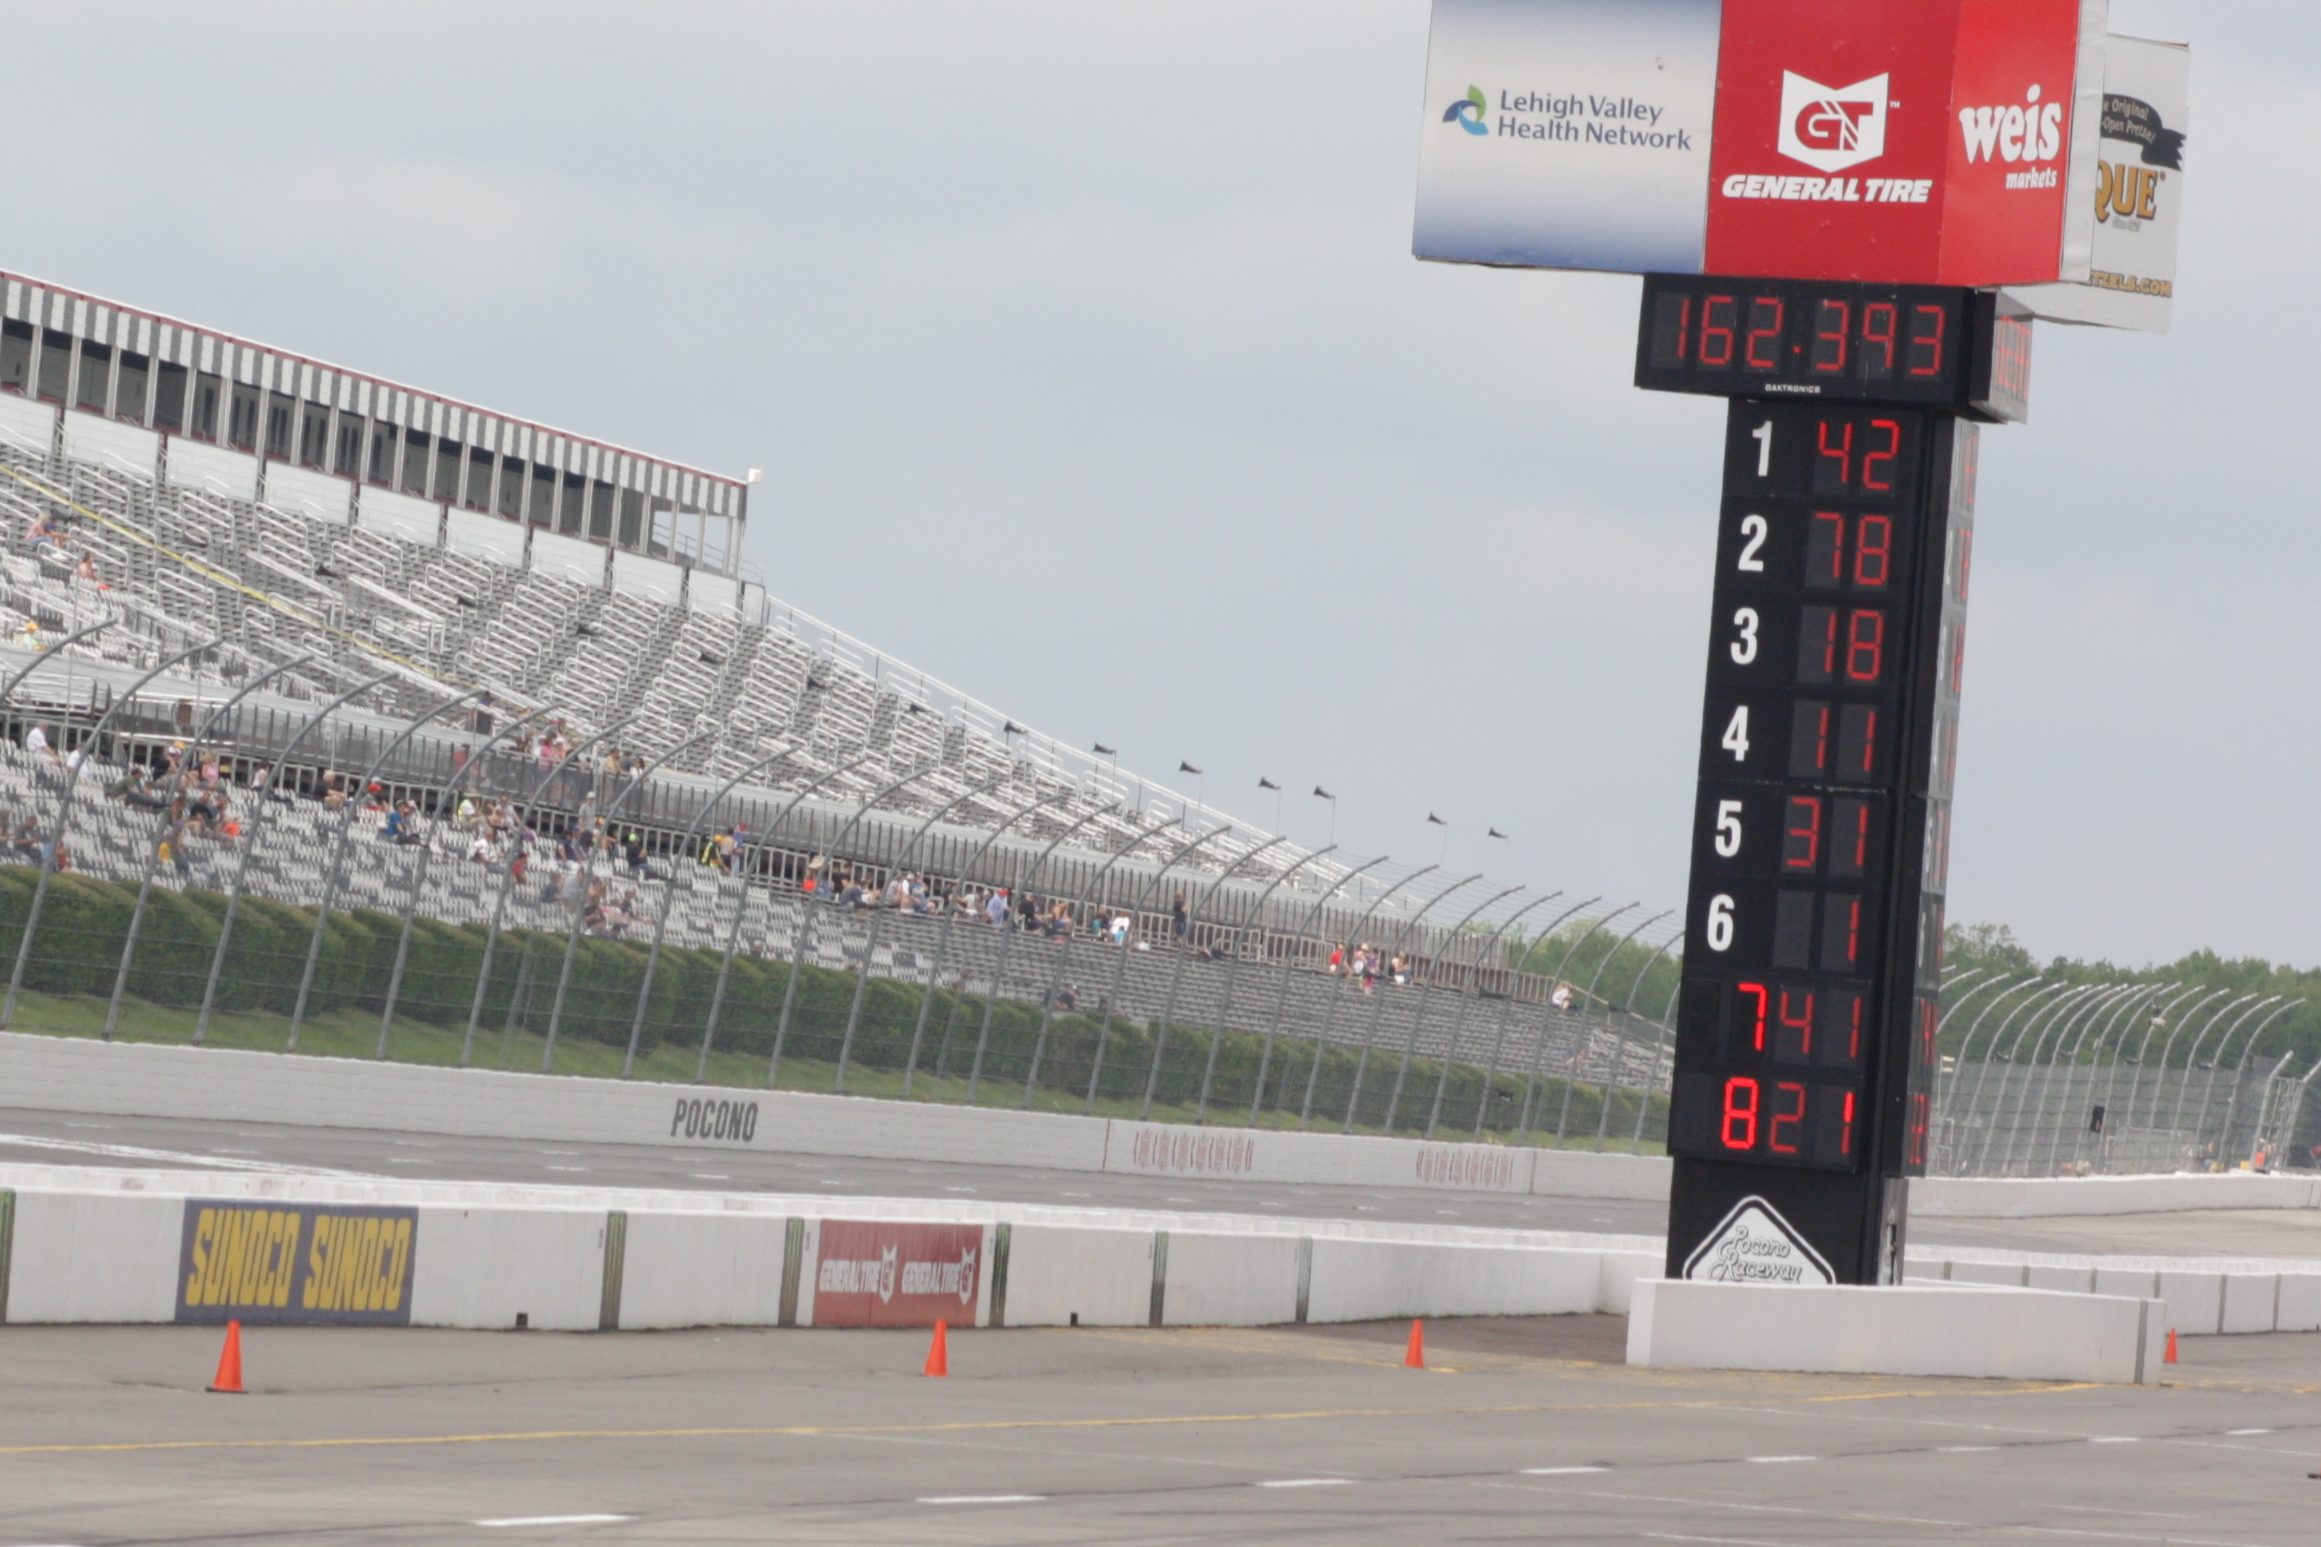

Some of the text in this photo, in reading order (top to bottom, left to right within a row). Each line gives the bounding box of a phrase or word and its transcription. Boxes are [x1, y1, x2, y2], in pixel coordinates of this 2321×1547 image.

[1500, 89, 1664, 127] Lehigh Valley
[1959, 83, 2062, 164] weis
[2111, 98, 2149, 121] Original
[1498, 115, 1693, 151] Health Network
[1722, 173, 1933, 203] GENERAL TIRE
[2005, 166, 2058, 190] markets
[1677, 295, 1946, 376] 162.393
[1752, 420, 1773, 477] 1
[1737, 514, 1768, 572] 2
[1730, 607, 1759, 665] 3
[1721, 705, 1749, 761] 4
[1714, 800, 1743, 857] 5
[1706, 894, 1735, 952] 6
[1847, 900, 1861, 961] 1
[670, 1098, 759, 1142] POCONO
[185, 1208, 412, 1311] SUNOCO SUNOCO
[1717, 1225, 1791, 1260] Pocono
[819, 1259, 859, 1293] GENERAL
[861, 1260, 881, 1293] TIRE
[902, 1262, 941, 1294] GENERAL
[1708, 1250, 1803, 1282] Raceway
